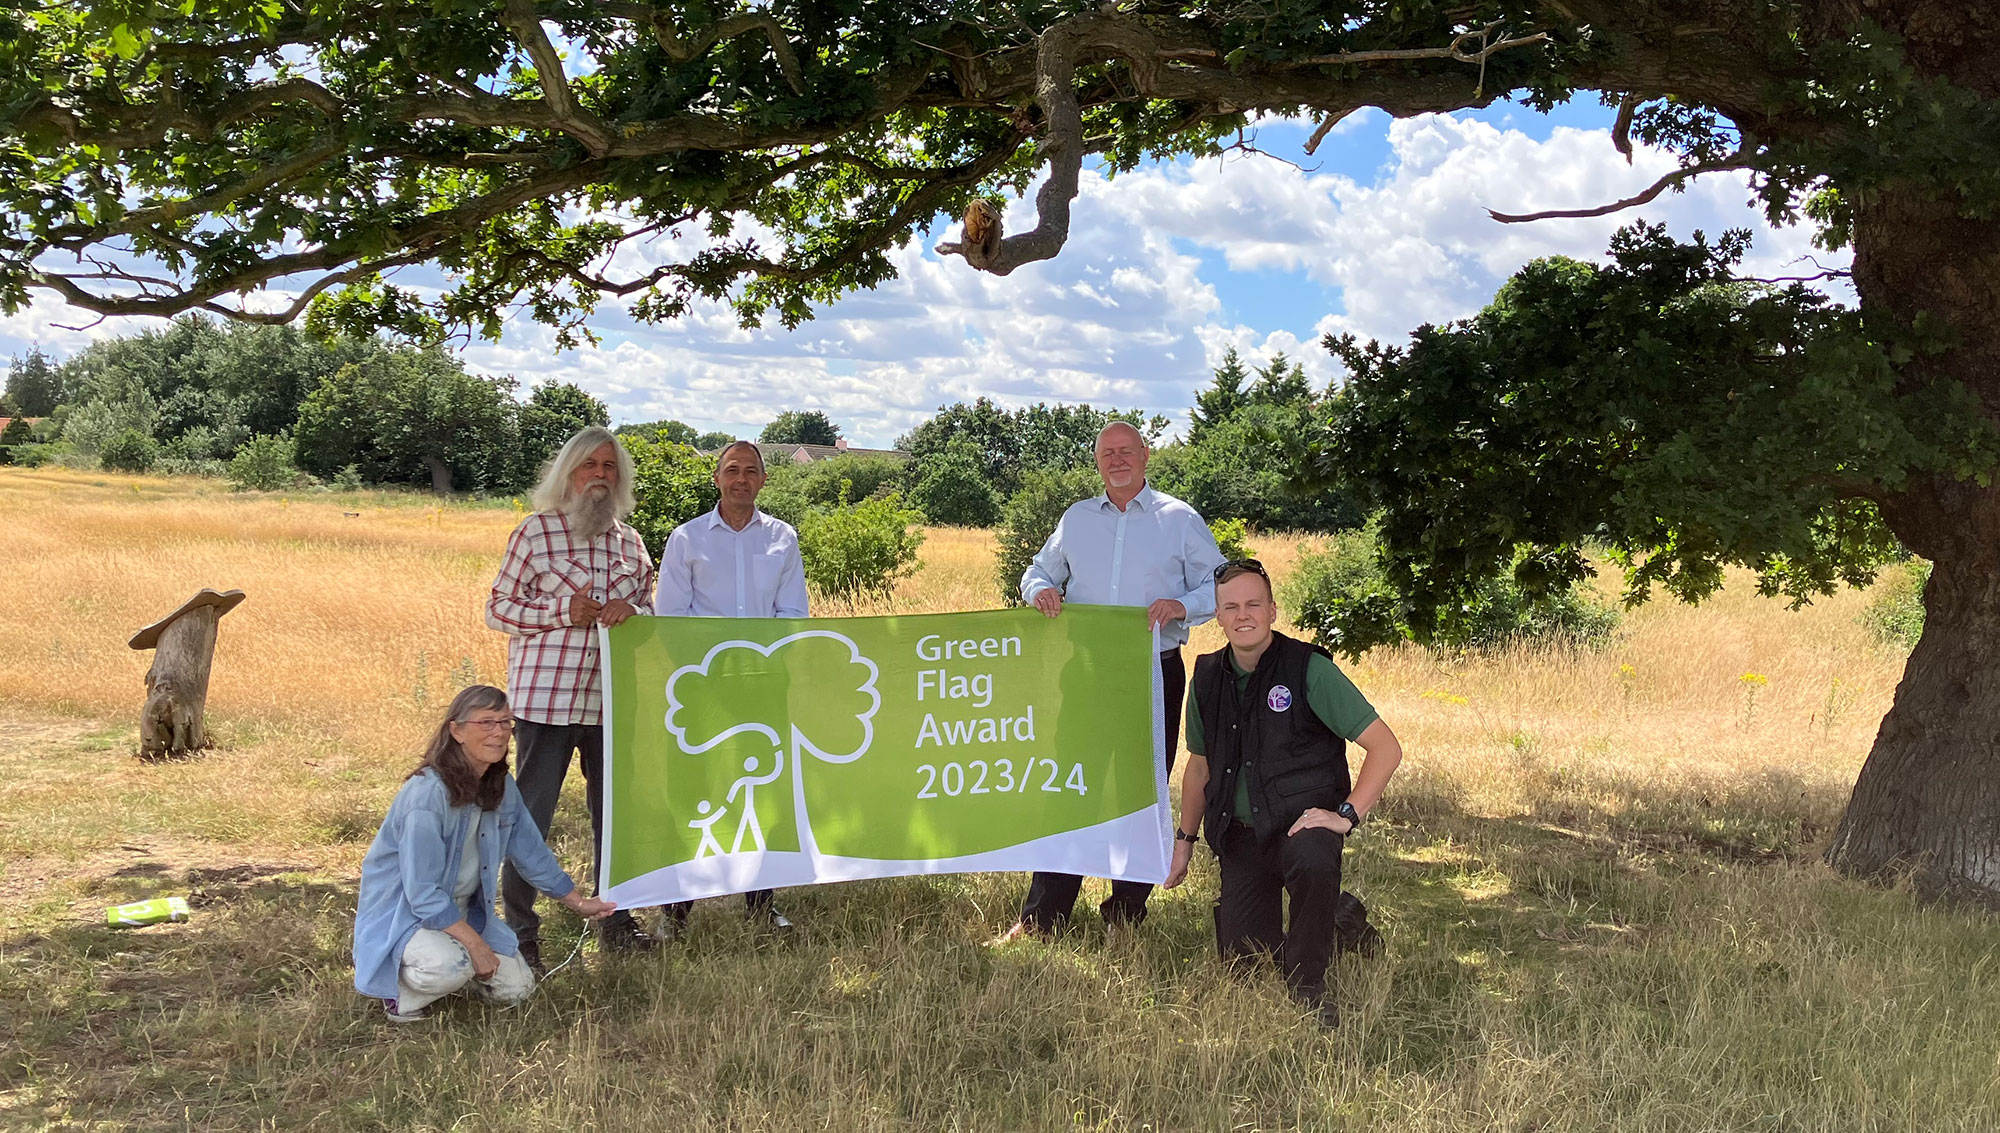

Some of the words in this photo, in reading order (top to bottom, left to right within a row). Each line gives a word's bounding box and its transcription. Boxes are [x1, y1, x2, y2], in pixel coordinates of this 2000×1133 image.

[915, 634, 1022, 661] Green
[917, 668, 993, 708] Flag
[914, 705, 1035, 748] Award
[915, 756, 1088, 799] 2023/24
